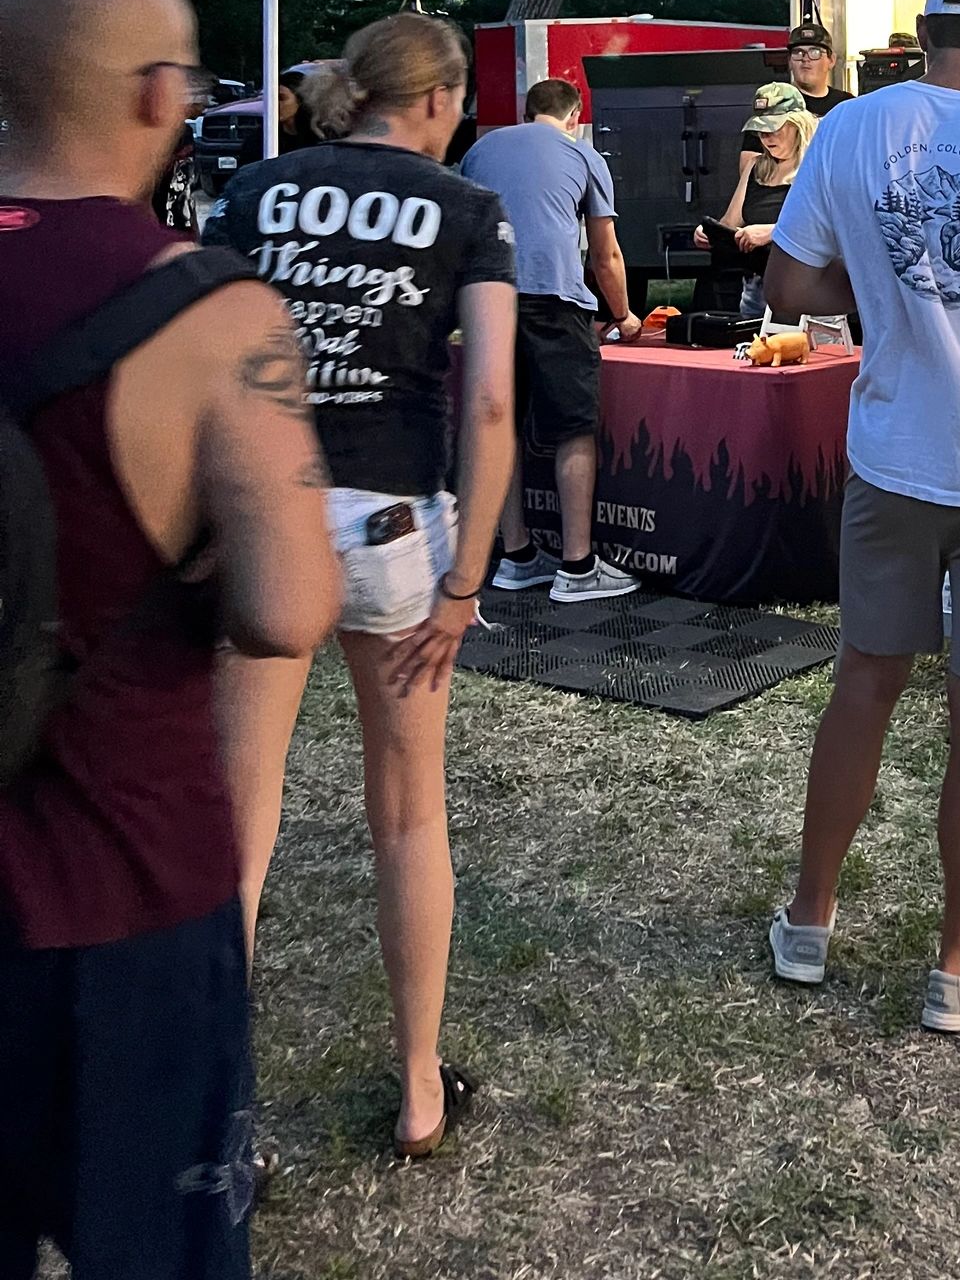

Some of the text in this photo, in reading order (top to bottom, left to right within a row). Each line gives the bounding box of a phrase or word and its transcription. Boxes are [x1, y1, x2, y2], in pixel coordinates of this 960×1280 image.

[883, 143, 932, 171] GOLDEN,
[257, 182, 442, 249] GOOD
[282, 298, 383, 327] appen
[596, 501, 656, 533] EVENTS
